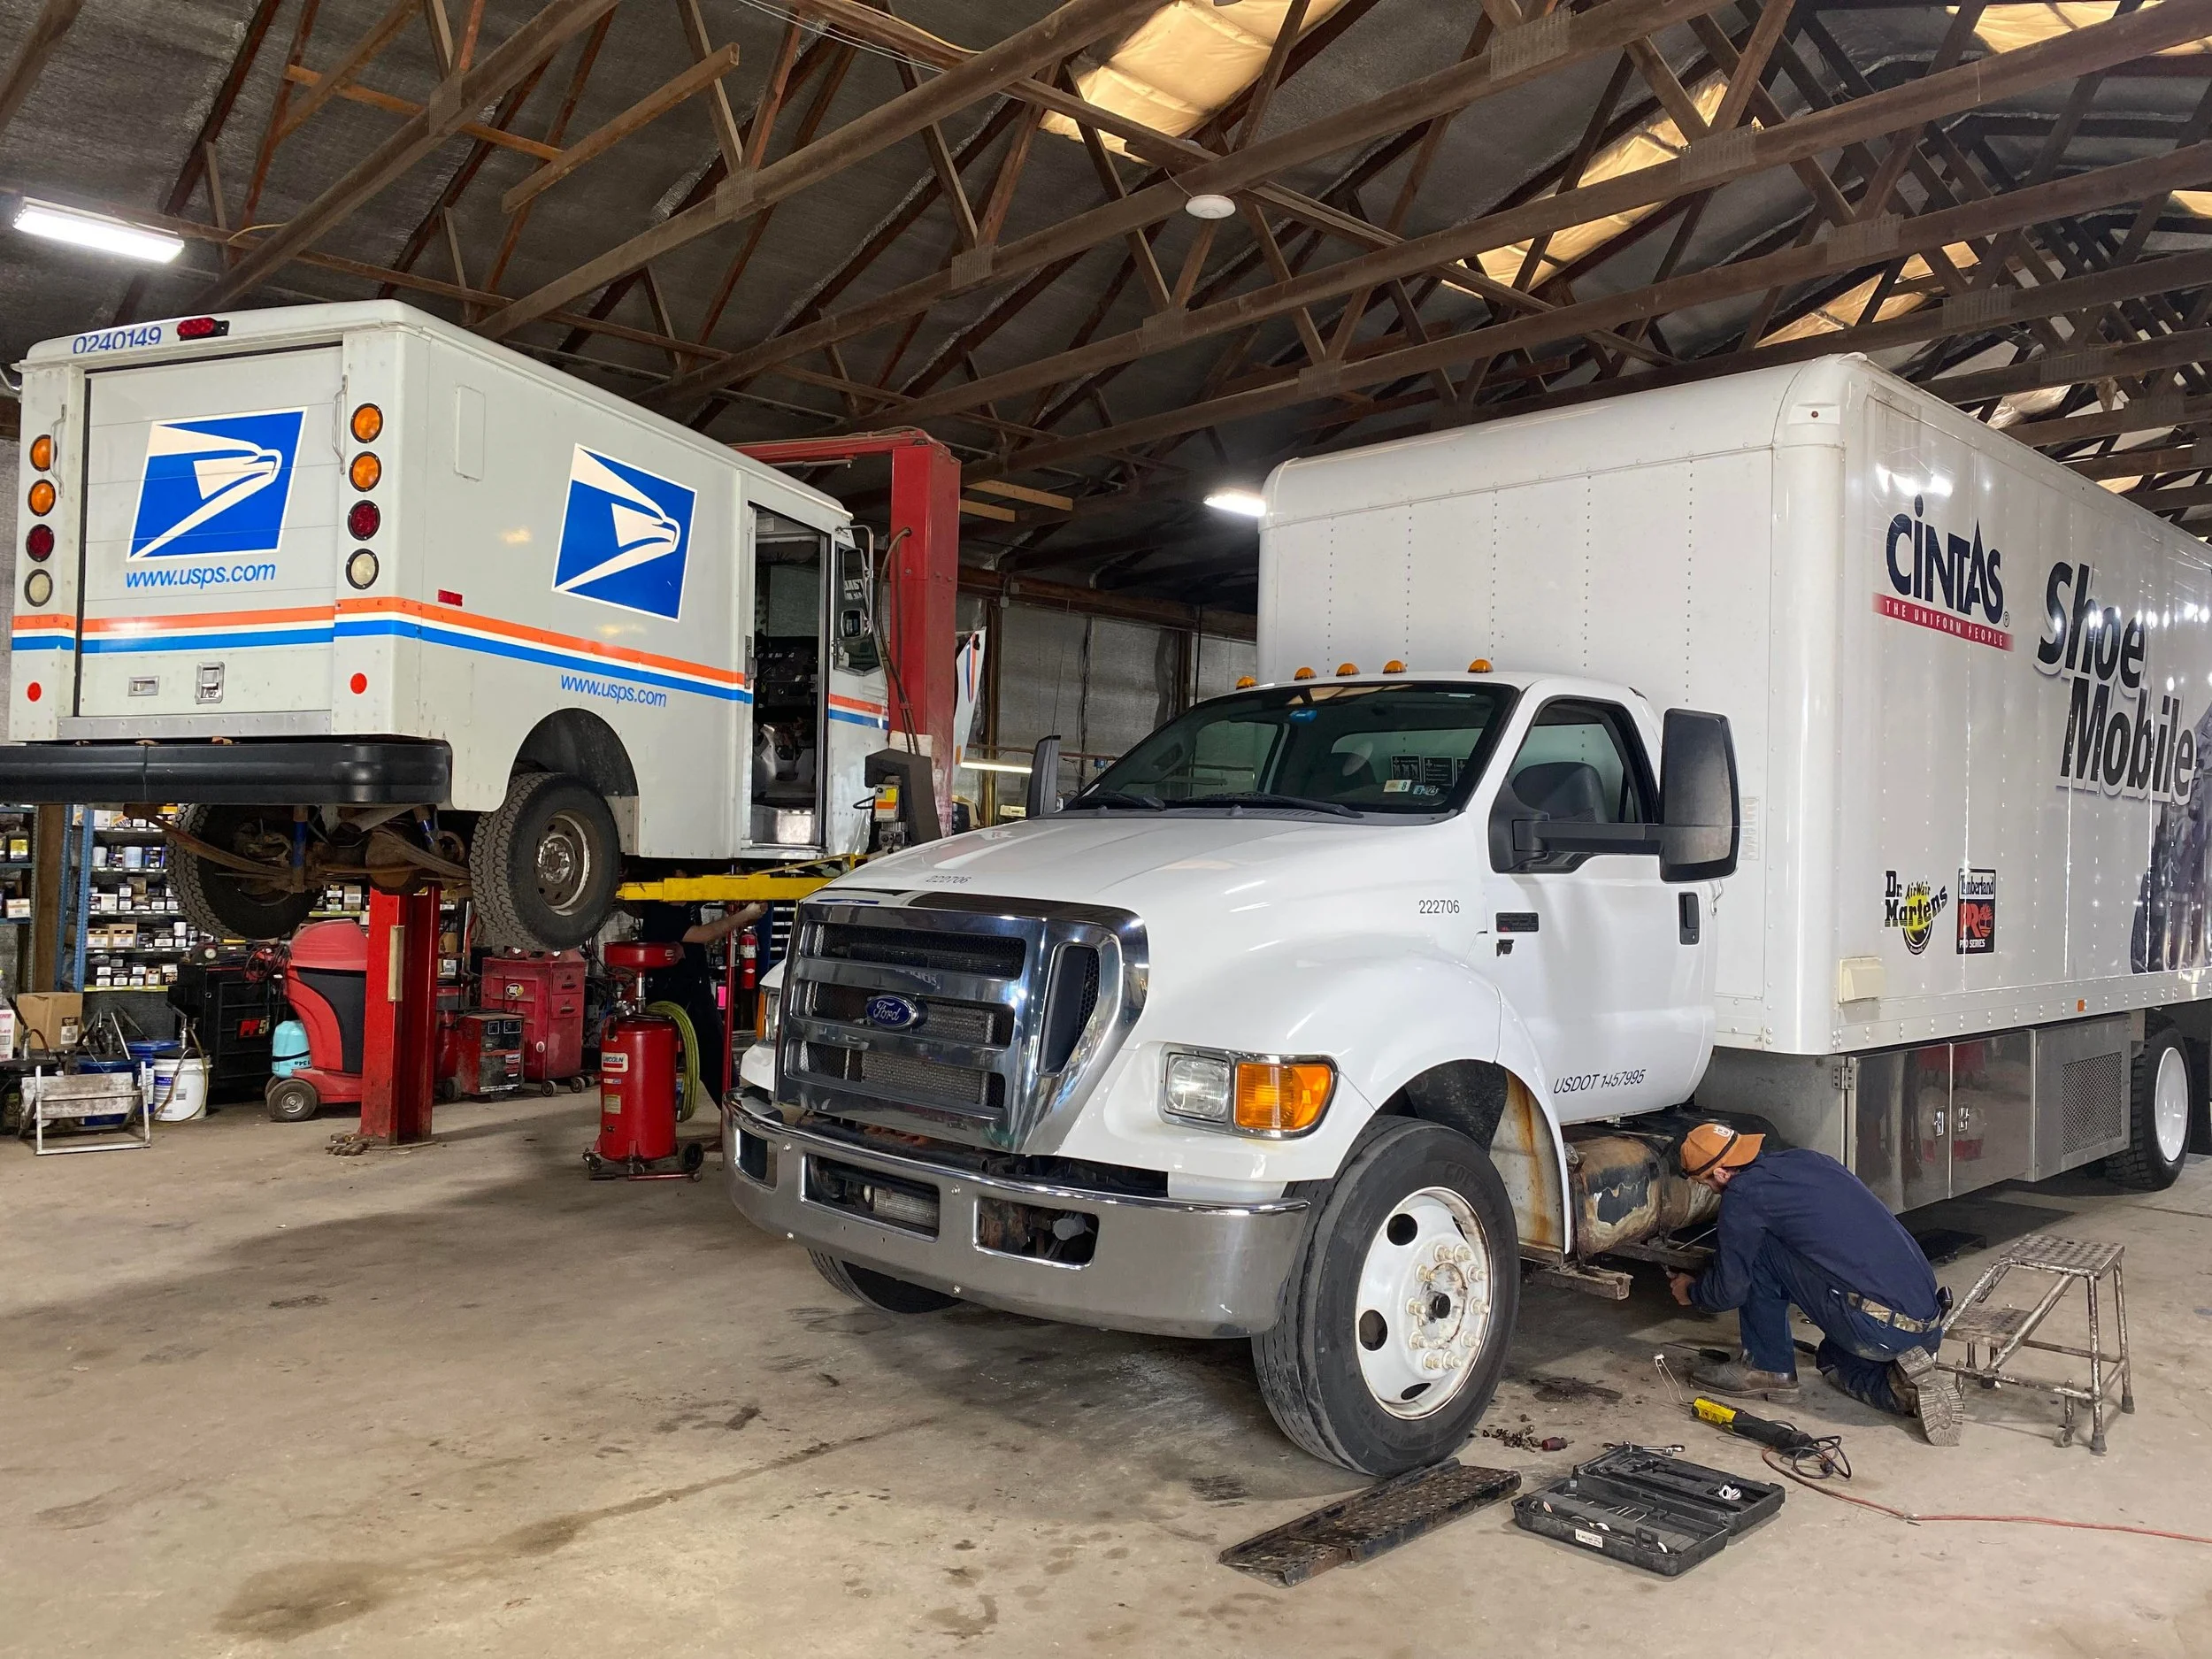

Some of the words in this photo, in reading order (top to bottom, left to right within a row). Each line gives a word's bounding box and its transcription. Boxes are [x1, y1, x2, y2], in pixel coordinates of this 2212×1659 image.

[73, 326, 162, 354] 0240149
[126, 563, 276, 590] www.usps.com
[1886, 600, 1907, 618] THE
[1914, 609, 1962, 634] UNIFORM
[1968, 625, 2003, 647] PEOPLE
[2037, 561, 2146, 689] Shoe
[560, 674, 667, 707] www.usps.com
[2060, 675, 2193, 797] Mobile
[926, 875, 972, 884] 222706
[1885, 870, 1902, 897] Dr.
[1960, 874, 1994, 895] Tmberland
[1418, 899, 1460, 914] 222706
[1884, 885, 1948, 927] Martens
[1959, 940, 1969, 949] PO
[1969, 939, 1985, 949] SERIES
[872, 1000, 901, 1021] Ford
[1554, 1074, 1600, 1094] USDOT
[1601, 1069, 1647, 1088] 1457995
